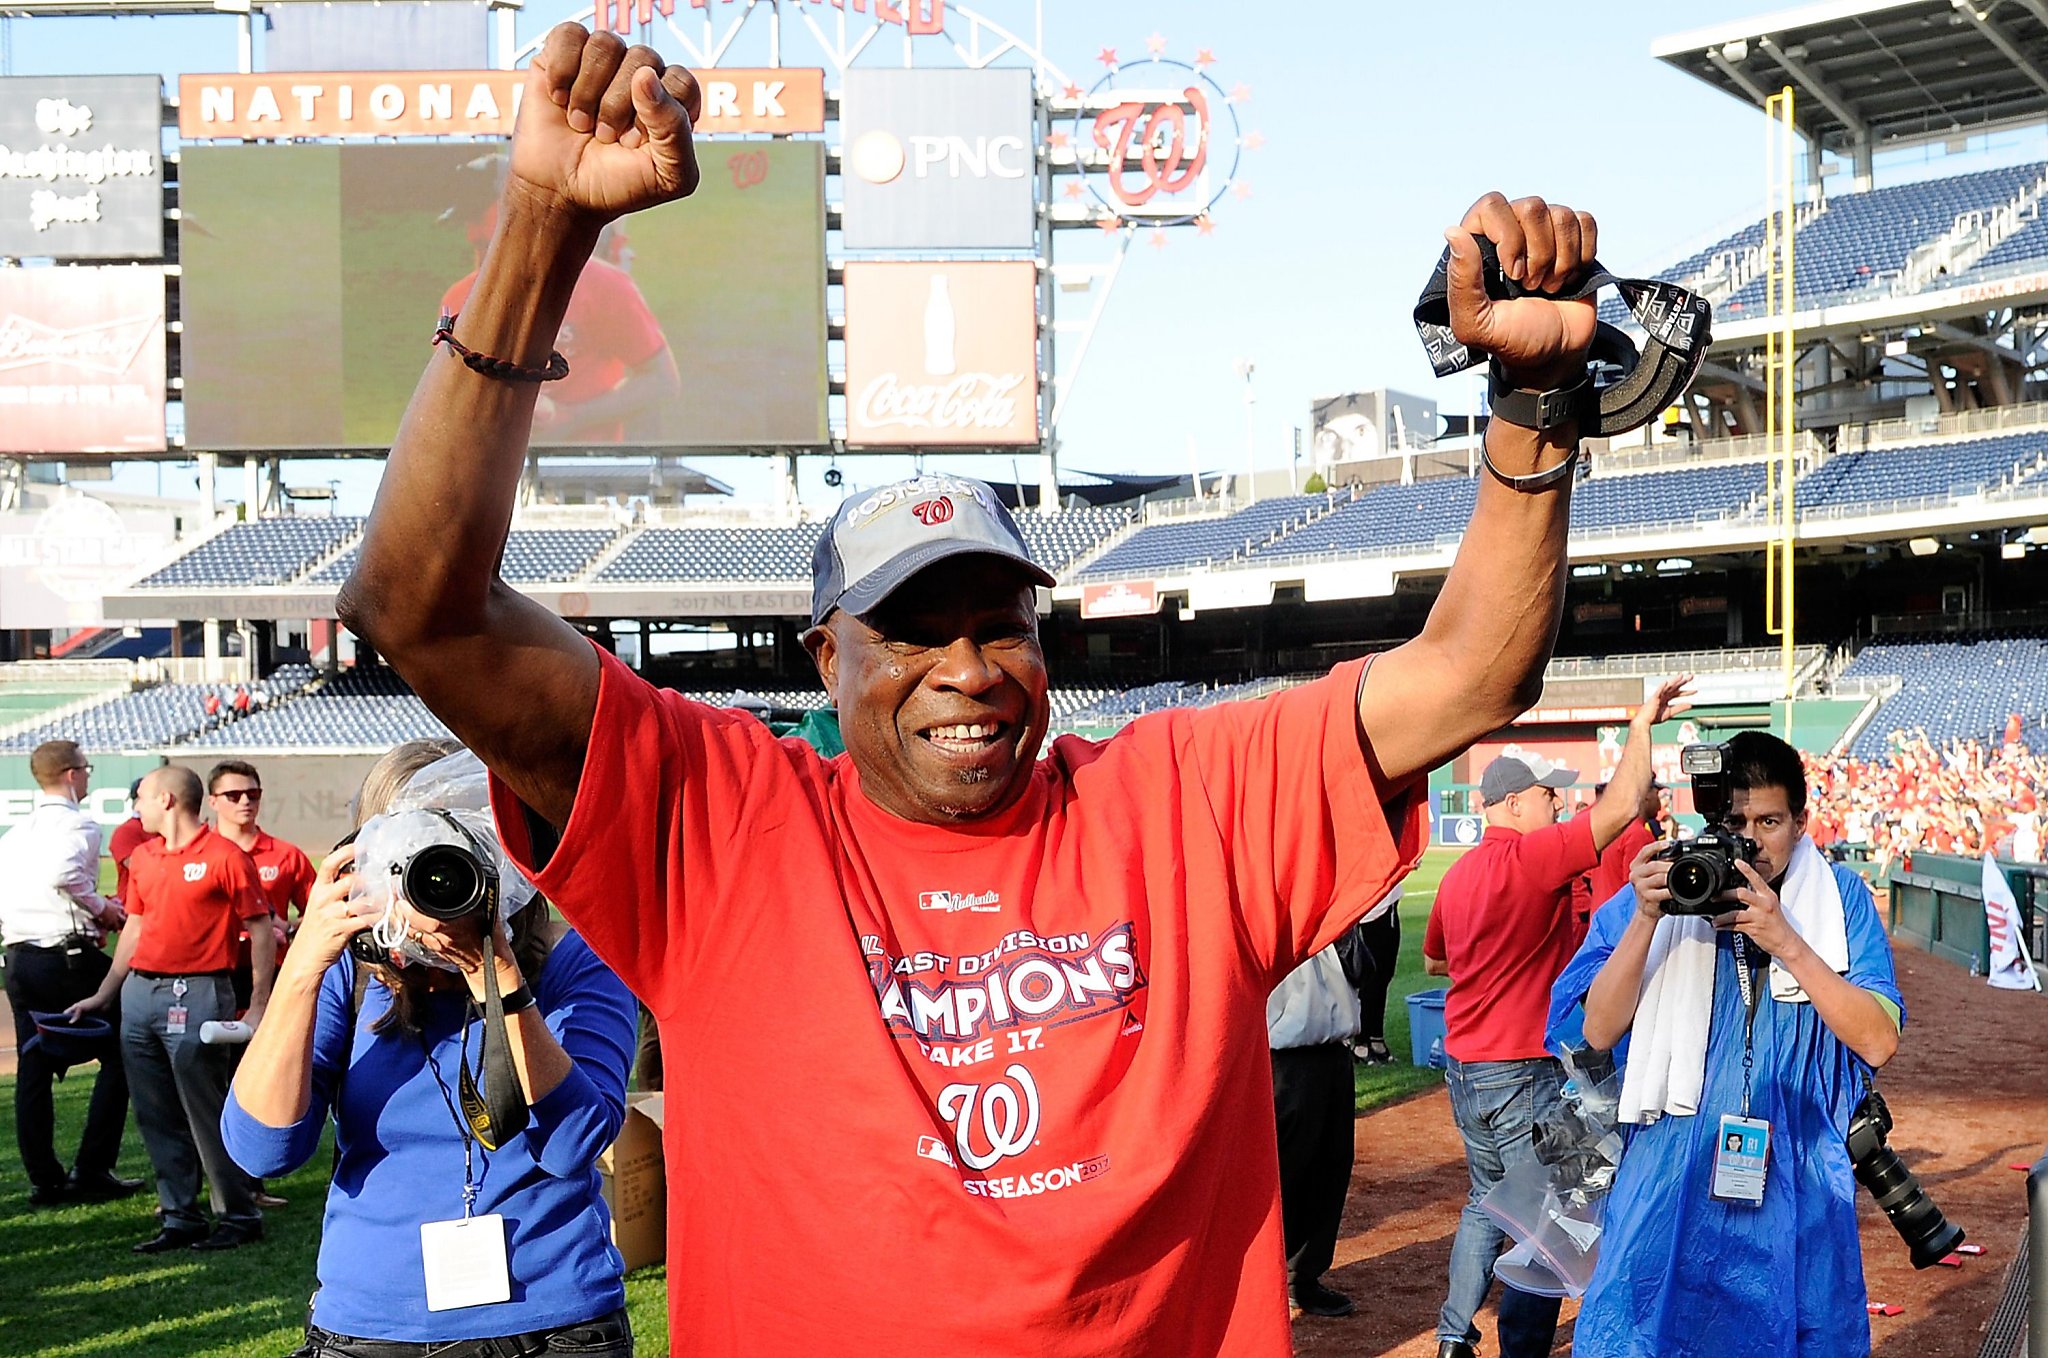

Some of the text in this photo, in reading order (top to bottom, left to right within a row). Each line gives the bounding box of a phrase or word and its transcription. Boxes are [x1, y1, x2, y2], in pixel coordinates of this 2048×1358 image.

[201, 82, 786, 122] NATIONA RK
[909, 136, 1024, 178] PNC
[912, 495, 954, 526] W
[284, 597, 337, 612] DIVIS
[712, 595, 737, 609] NL
[743, 594, 786, 608] EAST
[183, 861, 207, 882] W
[957, 930, 1090, 975] DIVISION
[1733, 933, 1745, 958] PRESS
[880, 932, 1138, 1037] AMPIONS
[936, 1062, 1041, 1172] W
[963, 1162, 1082, 1199] STSEASON
